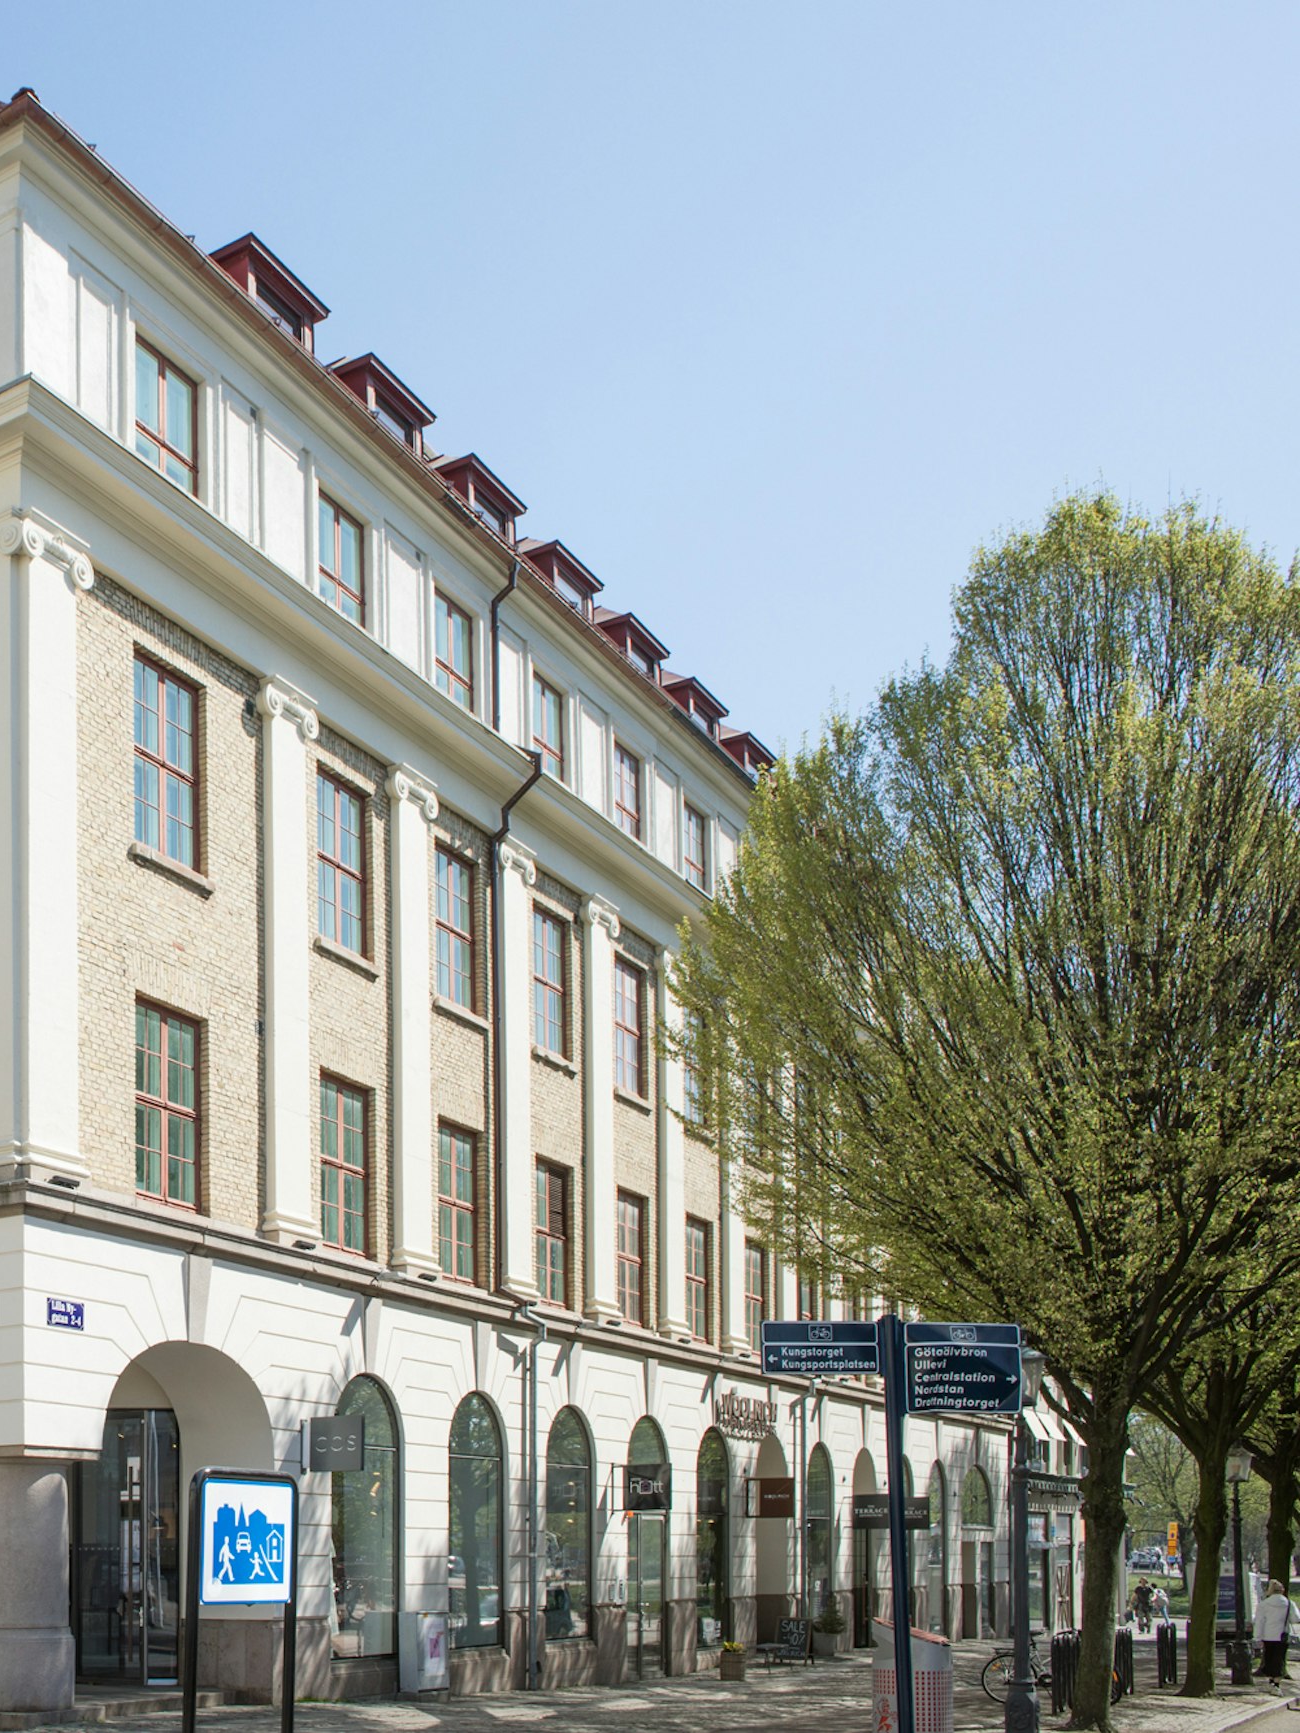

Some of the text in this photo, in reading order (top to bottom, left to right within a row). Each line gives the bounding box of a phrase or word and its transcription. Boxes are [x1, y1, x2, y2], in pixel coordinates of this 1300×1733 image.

[51, 1300, 76, 1315] Lilla Ny-
[51, 1314, 69, 1324] gatan
[781, 1347, 844, 1358] Kungstorget
[915, 1346, 988, 1357] Götaälvbron
[781, 1360, 876, 1371] Kungsportsplatsen
[914, 1359, 947, 1369] Ullevi
[915, 1371, 996, 1382] Centralstation
[915, 1385, 964, 1395] Nordstan
[915, 1396, 1000, 1409] Drottningtorget
[314, 1434, 357, 1453] COS
[854, 1507, 889, 1515] TERRACE
[781, 1620, 806, 1634] SALE
